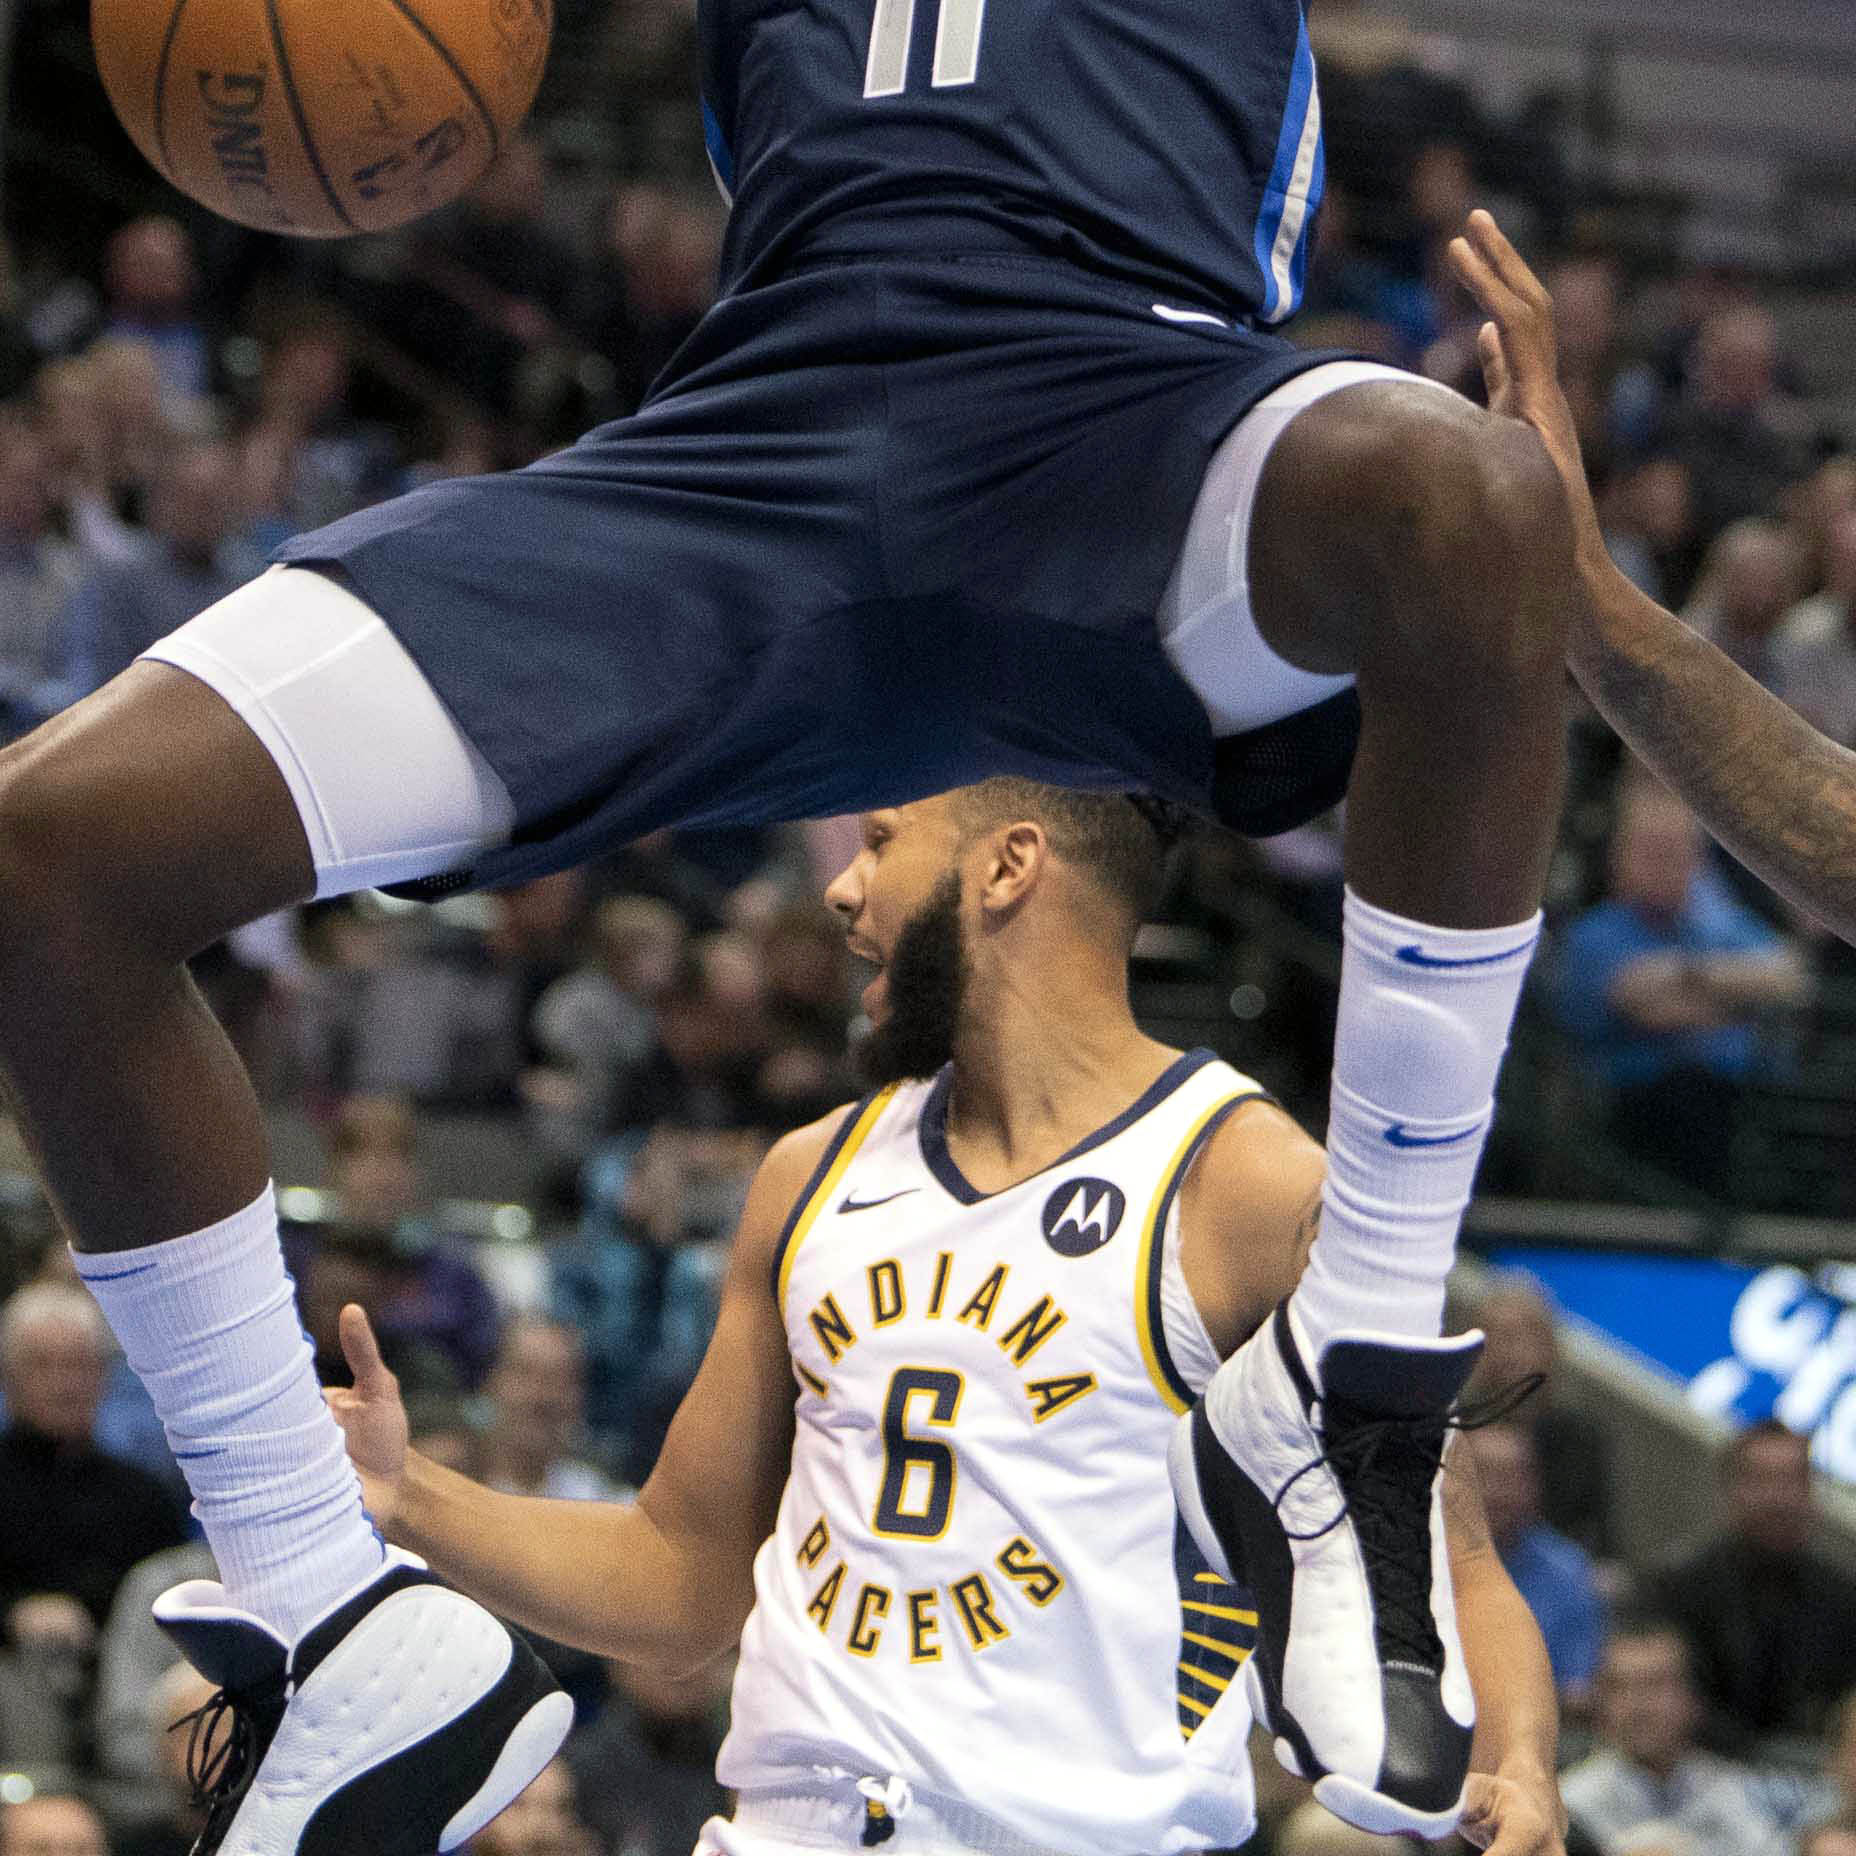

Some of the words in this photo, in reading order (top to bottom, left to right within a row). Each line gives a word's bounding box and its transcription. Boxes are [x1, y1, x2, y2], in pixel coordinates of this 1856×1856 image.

[795, 1251, 1098, 1425] INDIANA
[872, 1364, 966, 1543] 6
[796, 1515, 1064, 1665] PACERS
